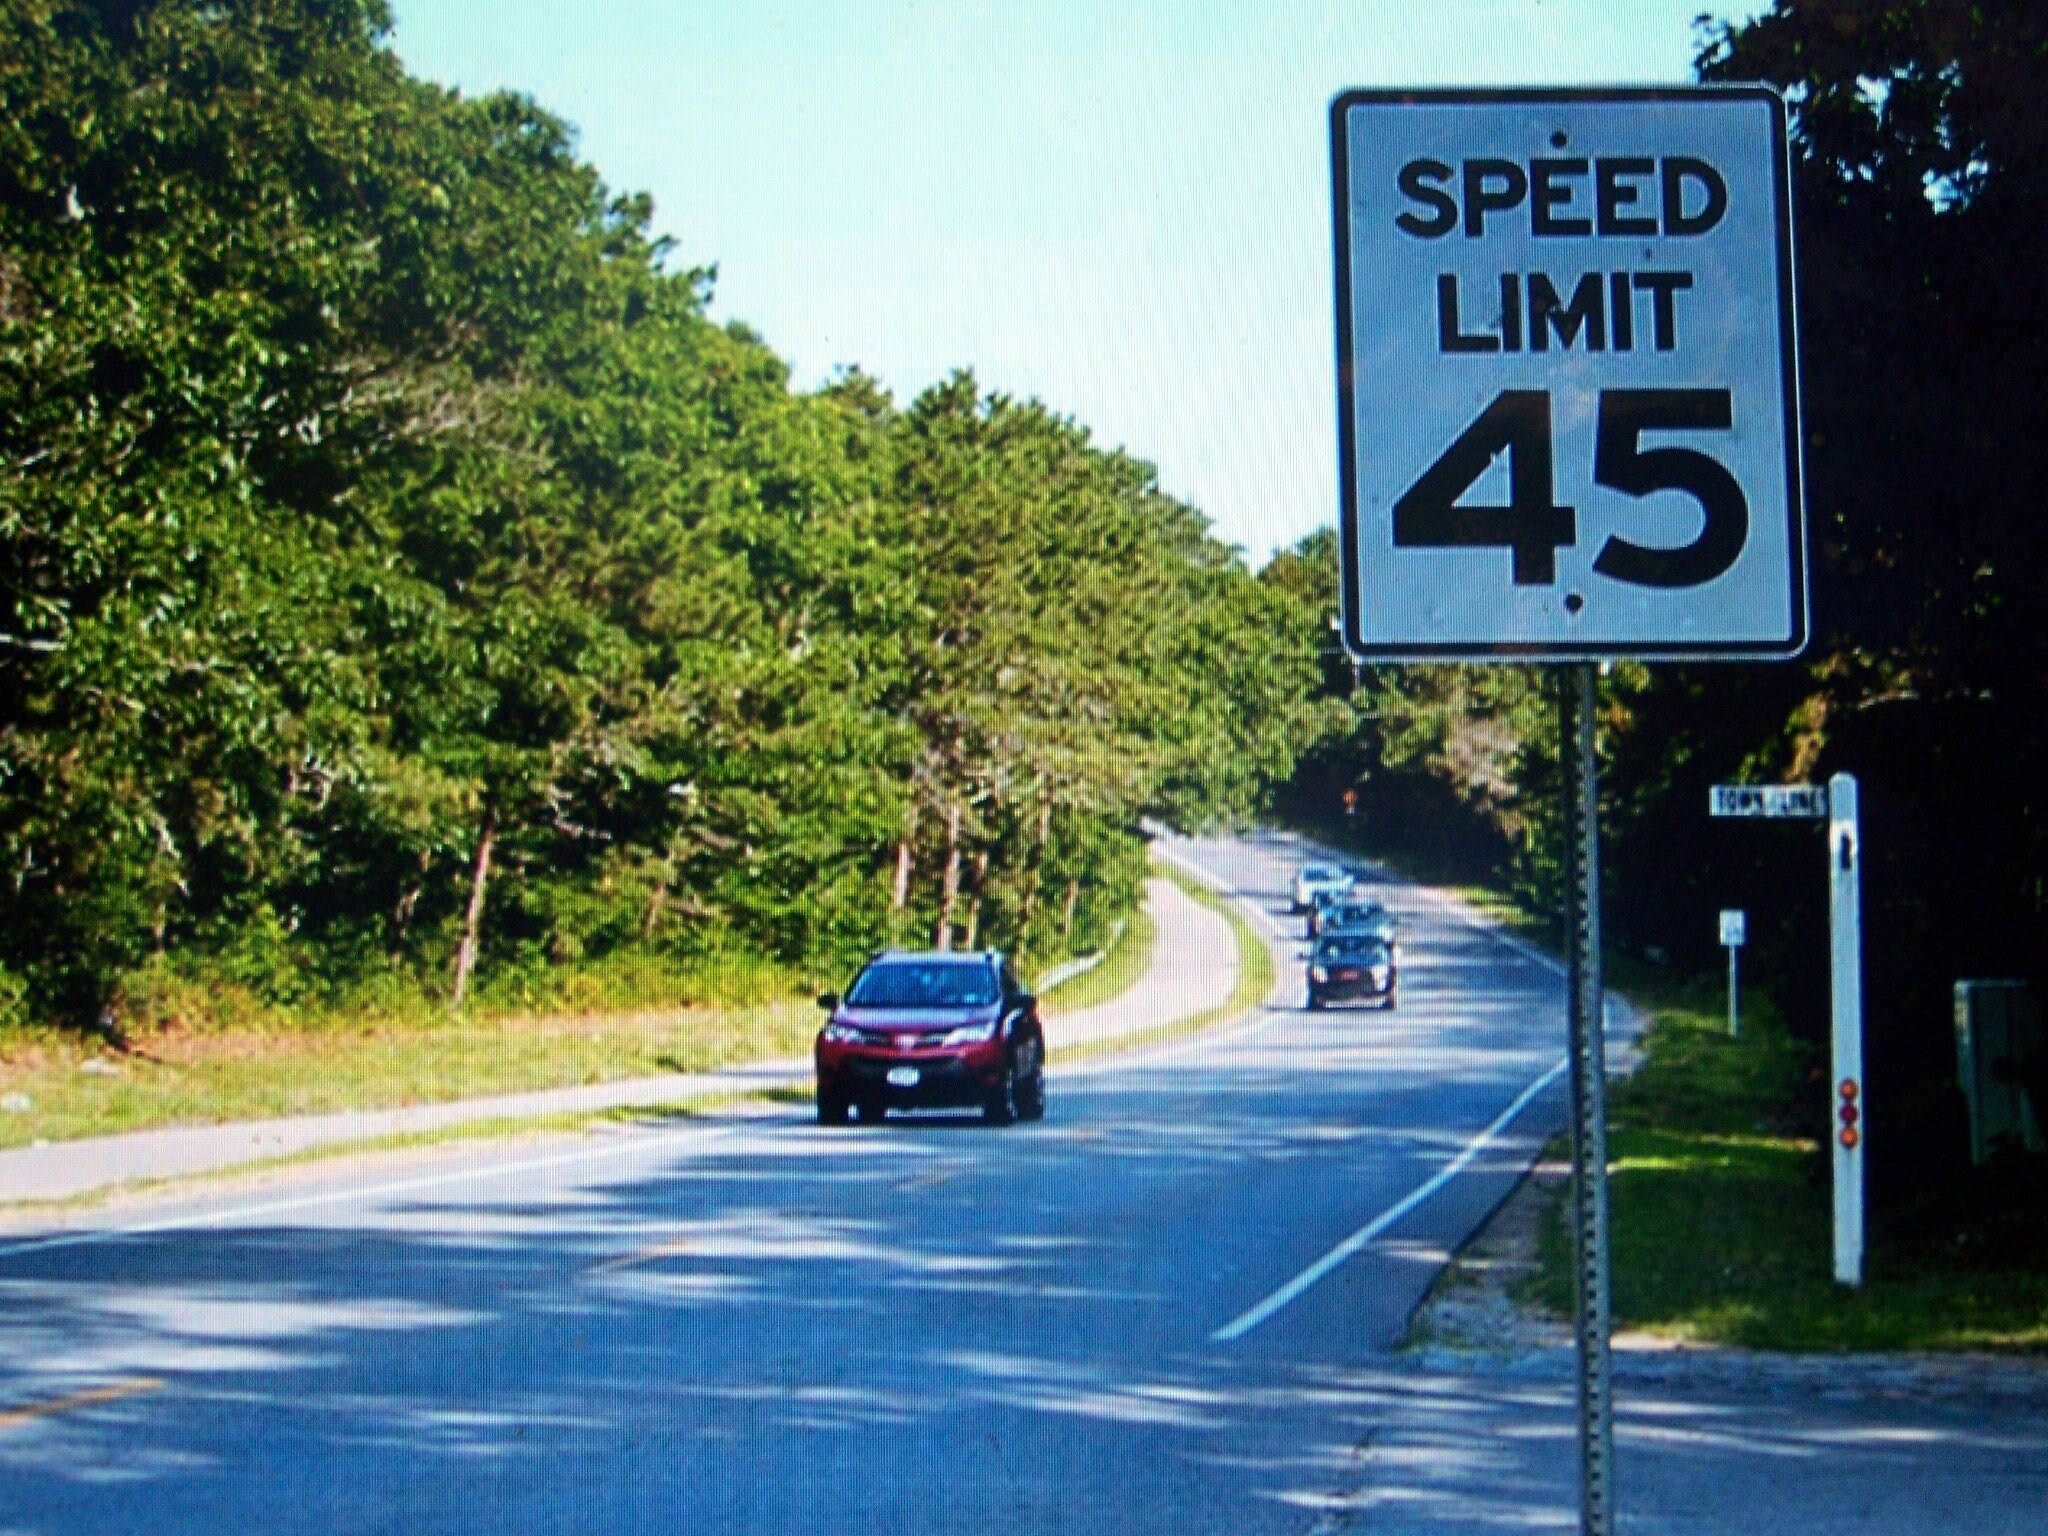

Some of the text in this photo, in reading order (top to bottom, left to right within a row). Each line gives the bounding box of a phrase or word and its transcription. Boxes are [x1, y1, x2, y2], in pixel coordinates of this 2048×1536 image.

[1396, 157, 1727, 238] SPEED
[1437, 272, 1692, 352] LIMIT
[1392, 388, 1748, 587] 45
